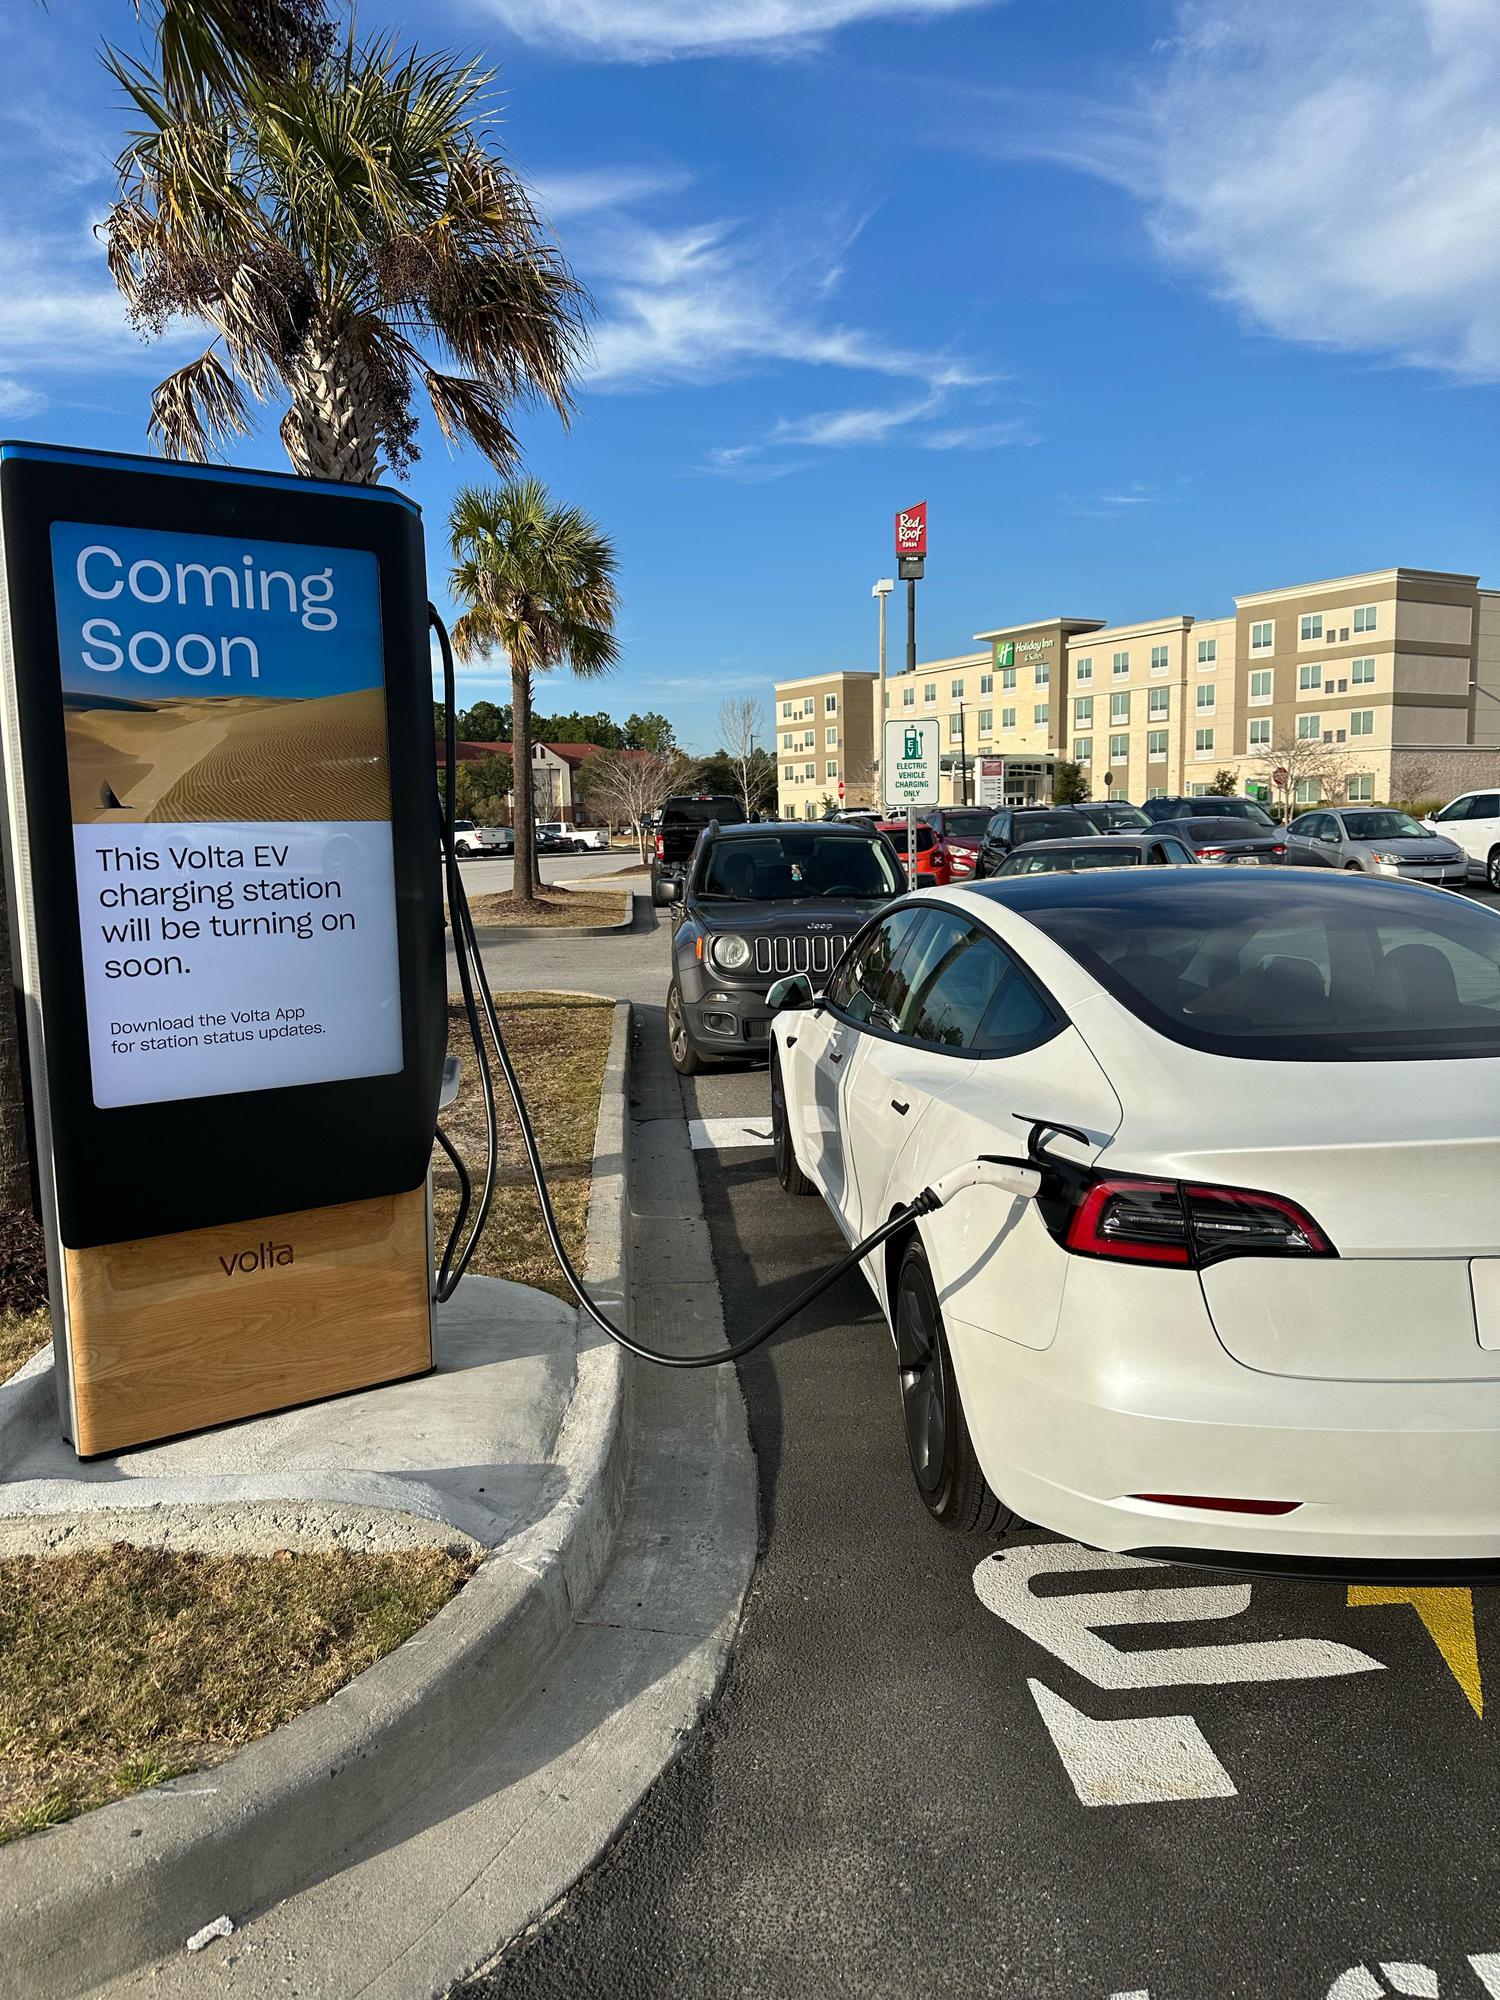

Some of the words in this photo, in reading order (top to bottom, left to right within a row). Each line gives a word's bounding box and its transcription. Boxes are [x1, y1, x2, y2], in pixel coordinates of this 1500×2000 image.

[900, 514, 920, 528] Red
[898, 525, 924, 542] Roof
[76, 545, 338, 632] Coming
[81, 619, 260, 678] Soon
[1015, 640, 1041, 653] Holiday
[1042, 637, 1053, 648] Inn
[896, 762, 928, 770] ELECTRIC
[898, 771, 926, 779] VEHICLE
[895, 780, 929, 789] CHARGING
[903, 790, 921, 798] ONLY
[96, 846, 160, 872] This
[168, 845, 244, 870] Volta
[254, 845, 289, 868] EV
[99, 880, 235, 912] charging
[242, 876, 342, 902] station
[101, 917, 151, 944] will
[161, 916, 200, 941] be
[209, 911, 314, 940] turning
[321, 912, 356, 932] on
[806, 922, 834, 931] Jeep
[104, 956, 191, 979] soon.
[110, 1015, 195, 1036] Download
[198, 1013, 227, 1028] the
[230, 1009, 271, 1024] Volta
[274, 1007, 306, 1022] App
[111, 1040, 136, 1055] for
[140, 1034, 199, 1052] station
[203, 1029, 255, 1046] status
[258, 1022, 327, 1042] updates.
[218, 1240, 295, 1277] volta
